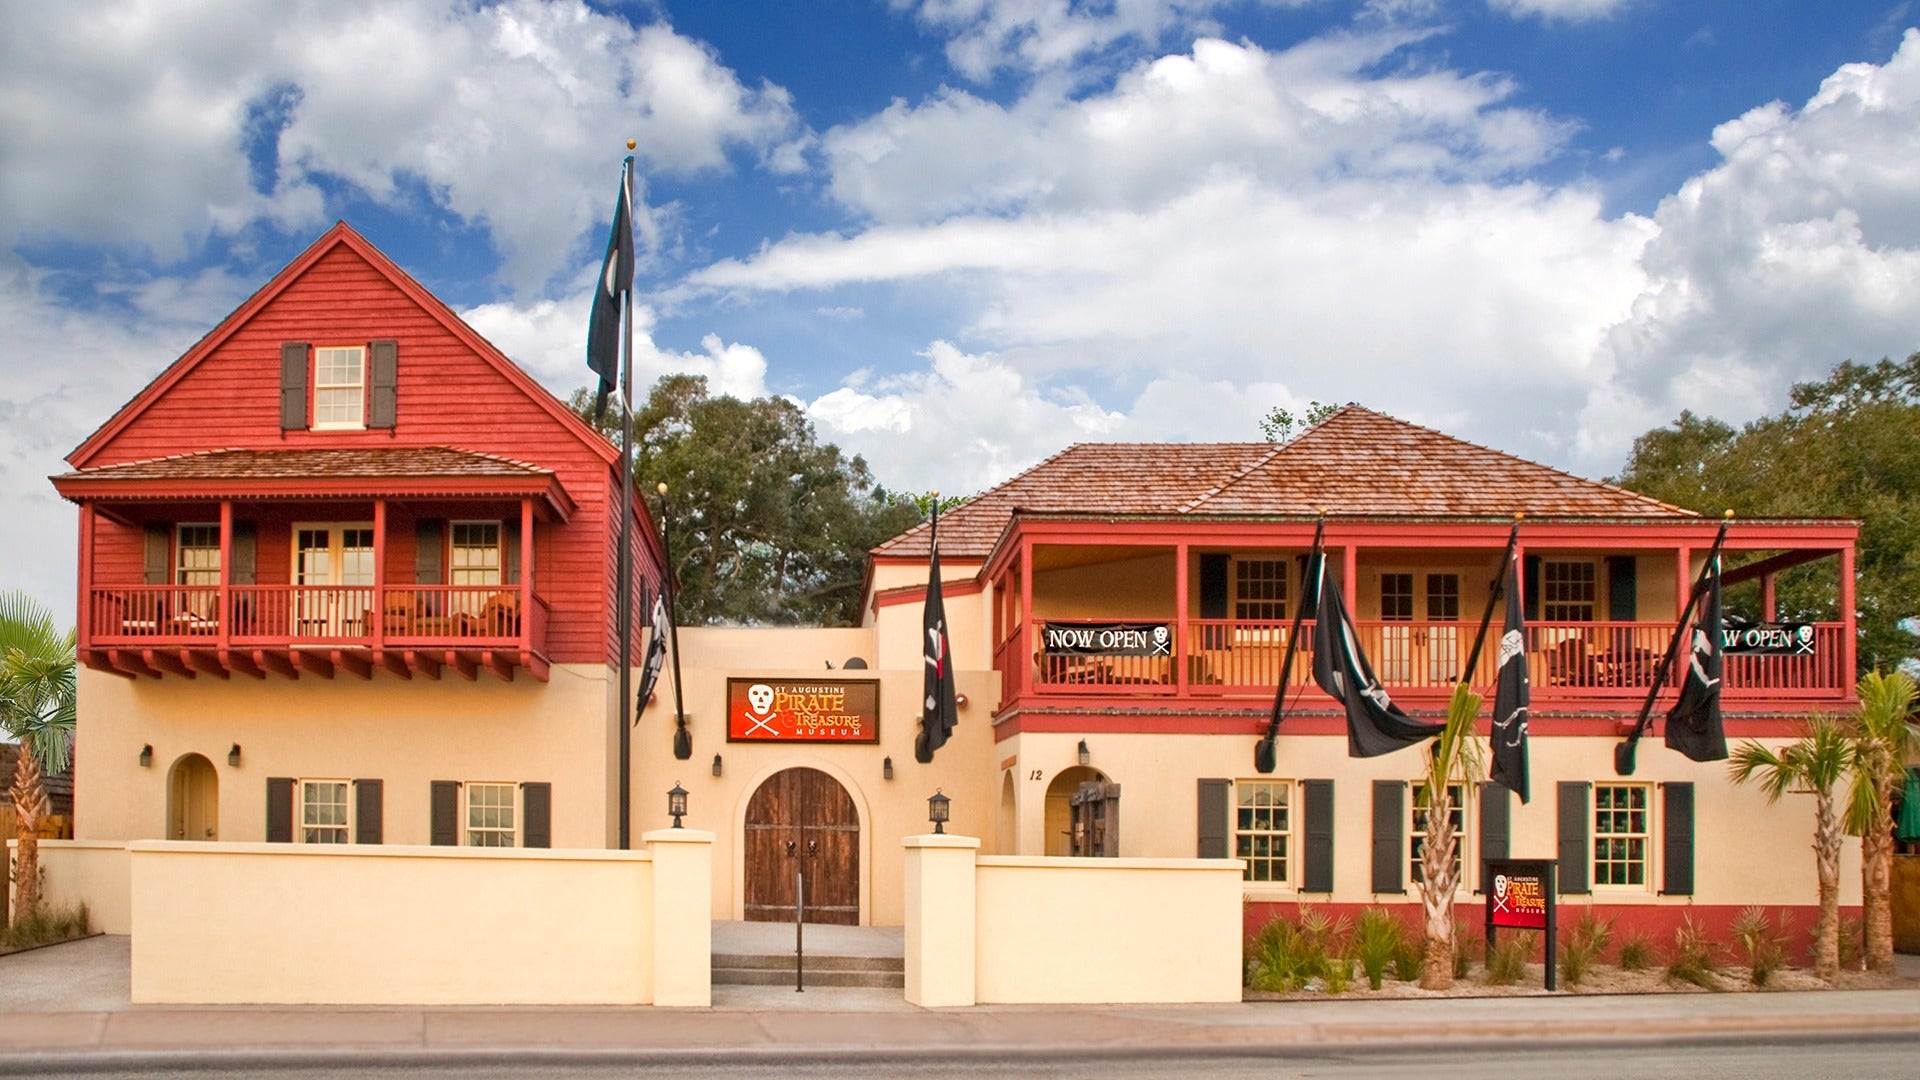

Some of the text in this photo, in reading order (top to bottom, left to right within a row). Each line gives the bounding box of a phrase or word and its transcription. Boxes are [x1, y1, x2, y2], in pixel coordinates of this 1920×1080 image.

[1049, 629, 1147, 648] NOW OPEN
[1745, 629, 1792, 648] OPEN
[774, 692, 844, 715] PIRATE
[794, 711, 861, 729] TREASURE
[796, 728, 860, 736] MUSEUM
[1030, 769, 1043, 781] 12
[1506, 881, 1538, 899] PIRATE
